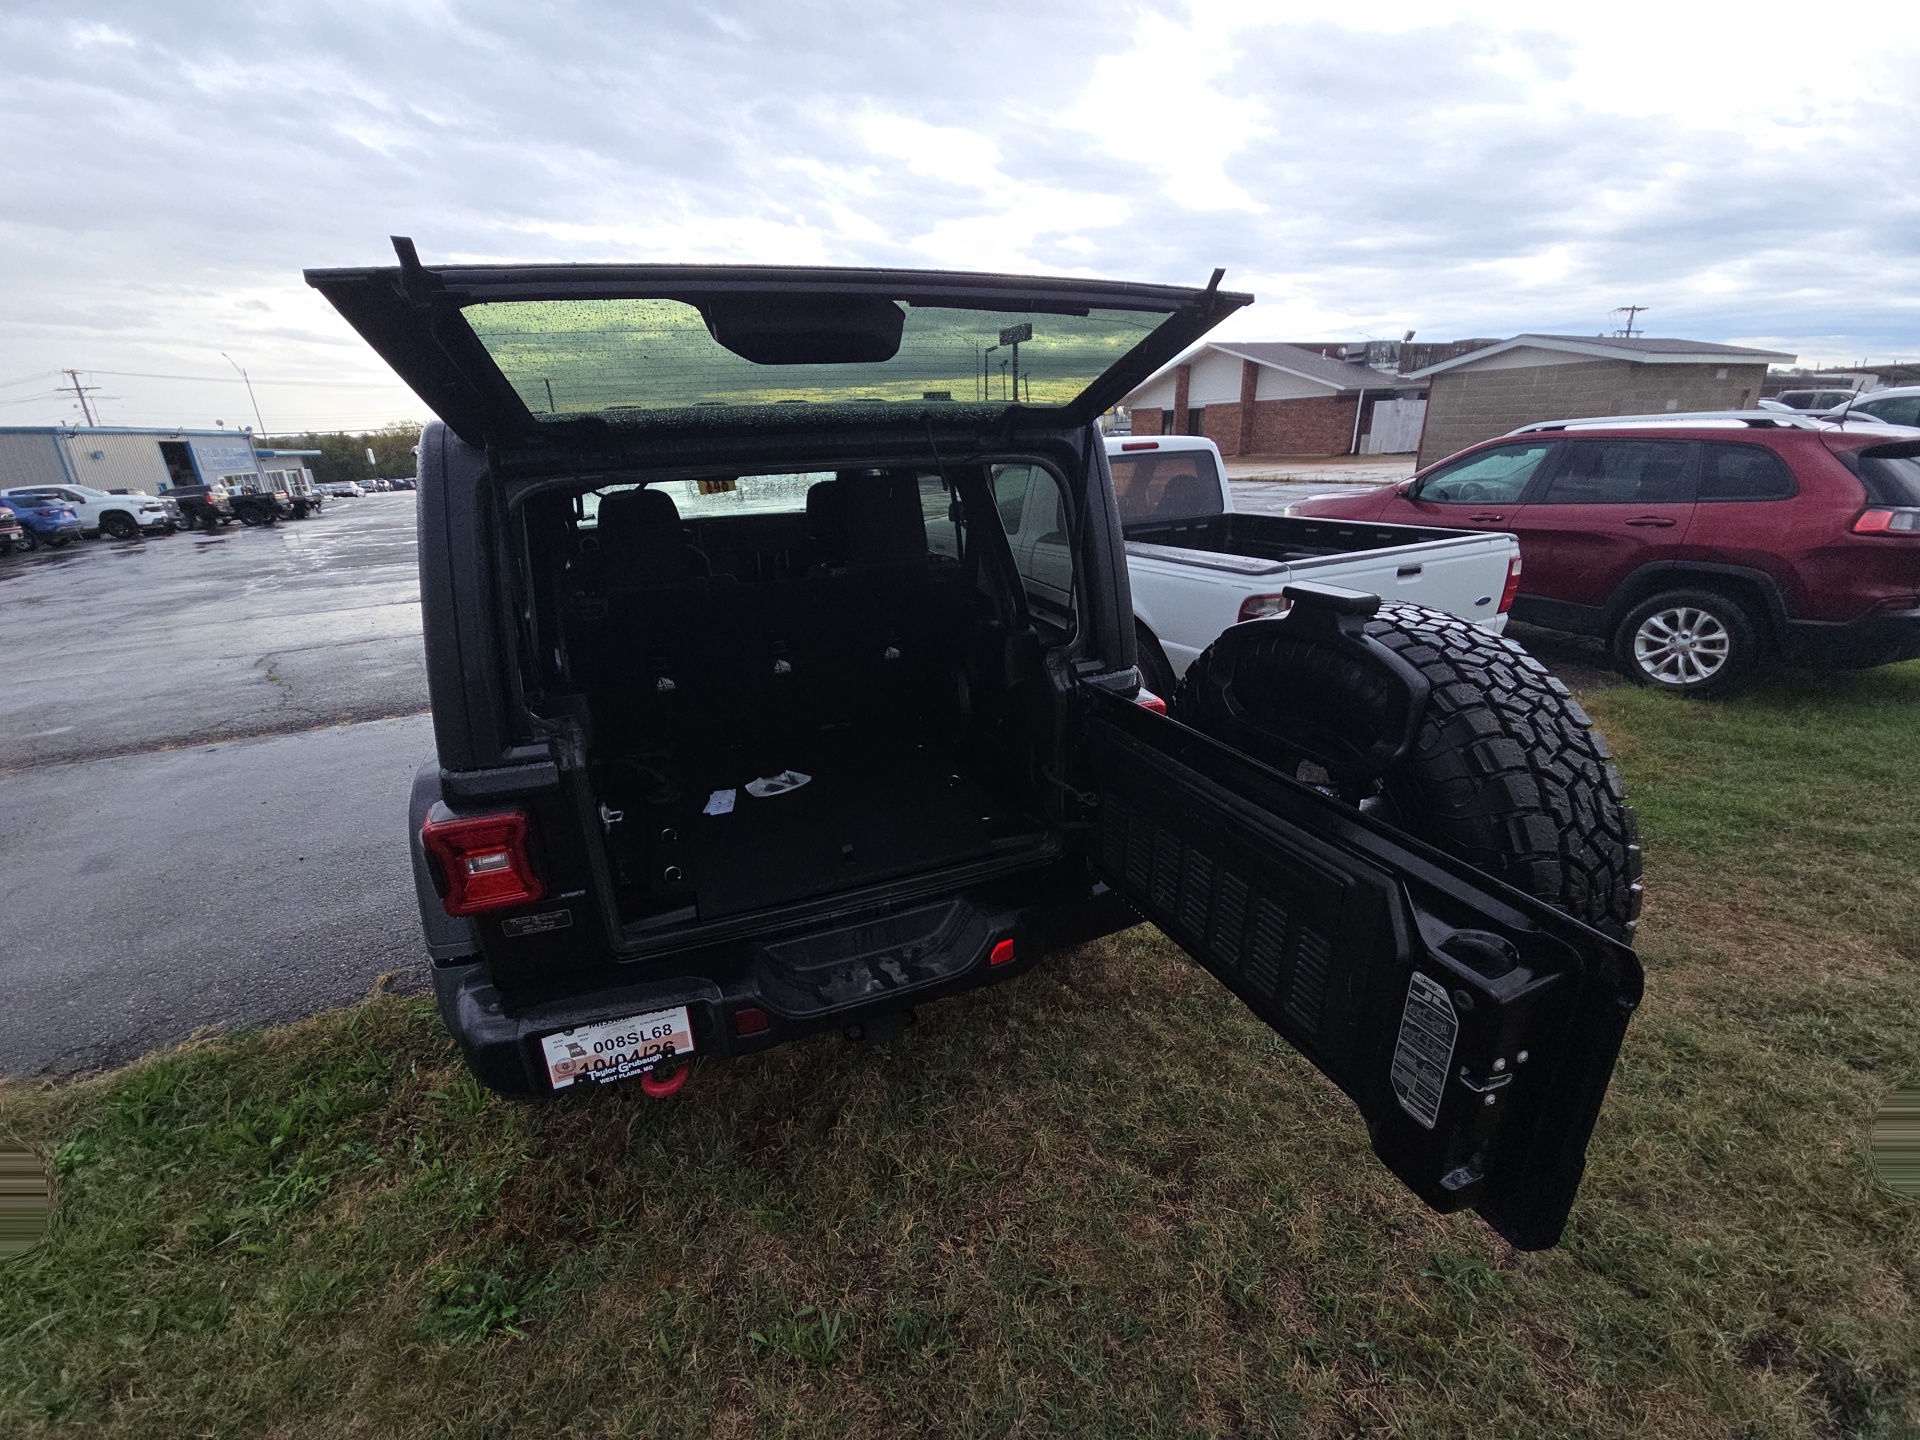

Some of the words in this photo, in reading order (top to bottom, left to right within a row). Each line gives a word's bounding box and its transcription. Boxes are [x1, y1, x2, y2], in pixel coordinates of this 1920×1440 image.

[1420, 978, 1438, 992] Jeep
[593, 1023, 673, 1054] 008SL68
[586, 1066, 617, 1081] Taylor
[617, 1053, 663, 1072] Grubaugh
[599, 1076, 618, 1084] WEST
